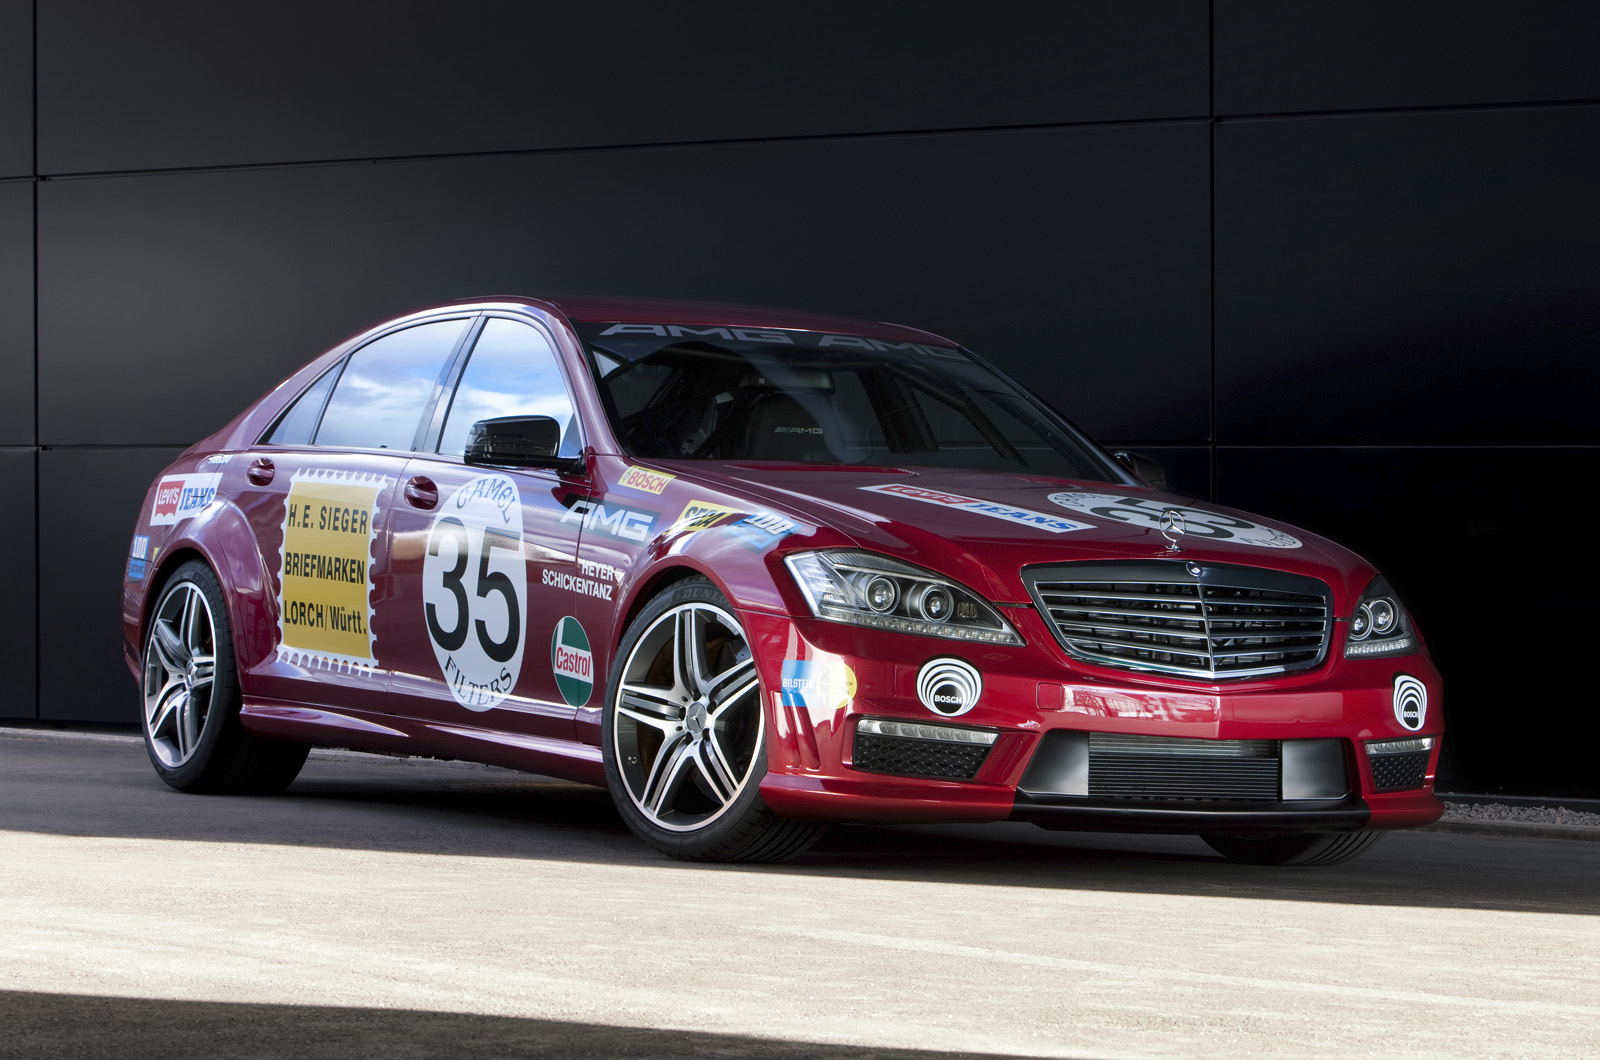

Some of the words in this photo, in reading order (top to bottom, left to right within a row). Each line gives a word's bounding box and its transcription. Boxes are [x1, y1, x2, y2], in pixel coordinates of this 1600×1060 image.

[600, 323, 794, 345] AMG
[818, 334, 972, 362] AMG
[789, 427, 824, 435] AMG
[627, 471, 669, 493] BOSCH
[179, 487, 215, 511] JEANS
[456, 478, 516, 525] CAMEL
[288, 503, 314, 529] H.E.
[319, 505, 369, 535] SIEGER
[559, 499, 654, 542] AMG
[743, 510, 797, 535] 100
[964, 503, 1078, 530] JEANS
[1090, 497, 1256, 539] 35
[131, 536, 148, 560] 100
[284, 551, 365, 585] BRIEFMARKEN
[581, 559, 615, 582] HEYER
[425, 516, 522, 663] 35
[542, 568, 613, 601] SCHICKENTANZ
[682, 588, 729, 605] DUNLO
[556, 646, 591, 678] Castrol
[444, 654, 512, 705] FILTERS
[782, 678, 815, 689] BILSTEIN
[934, 694, 962, 704] BOSCH
[1403, 710, 1419, 718] BOSCH
